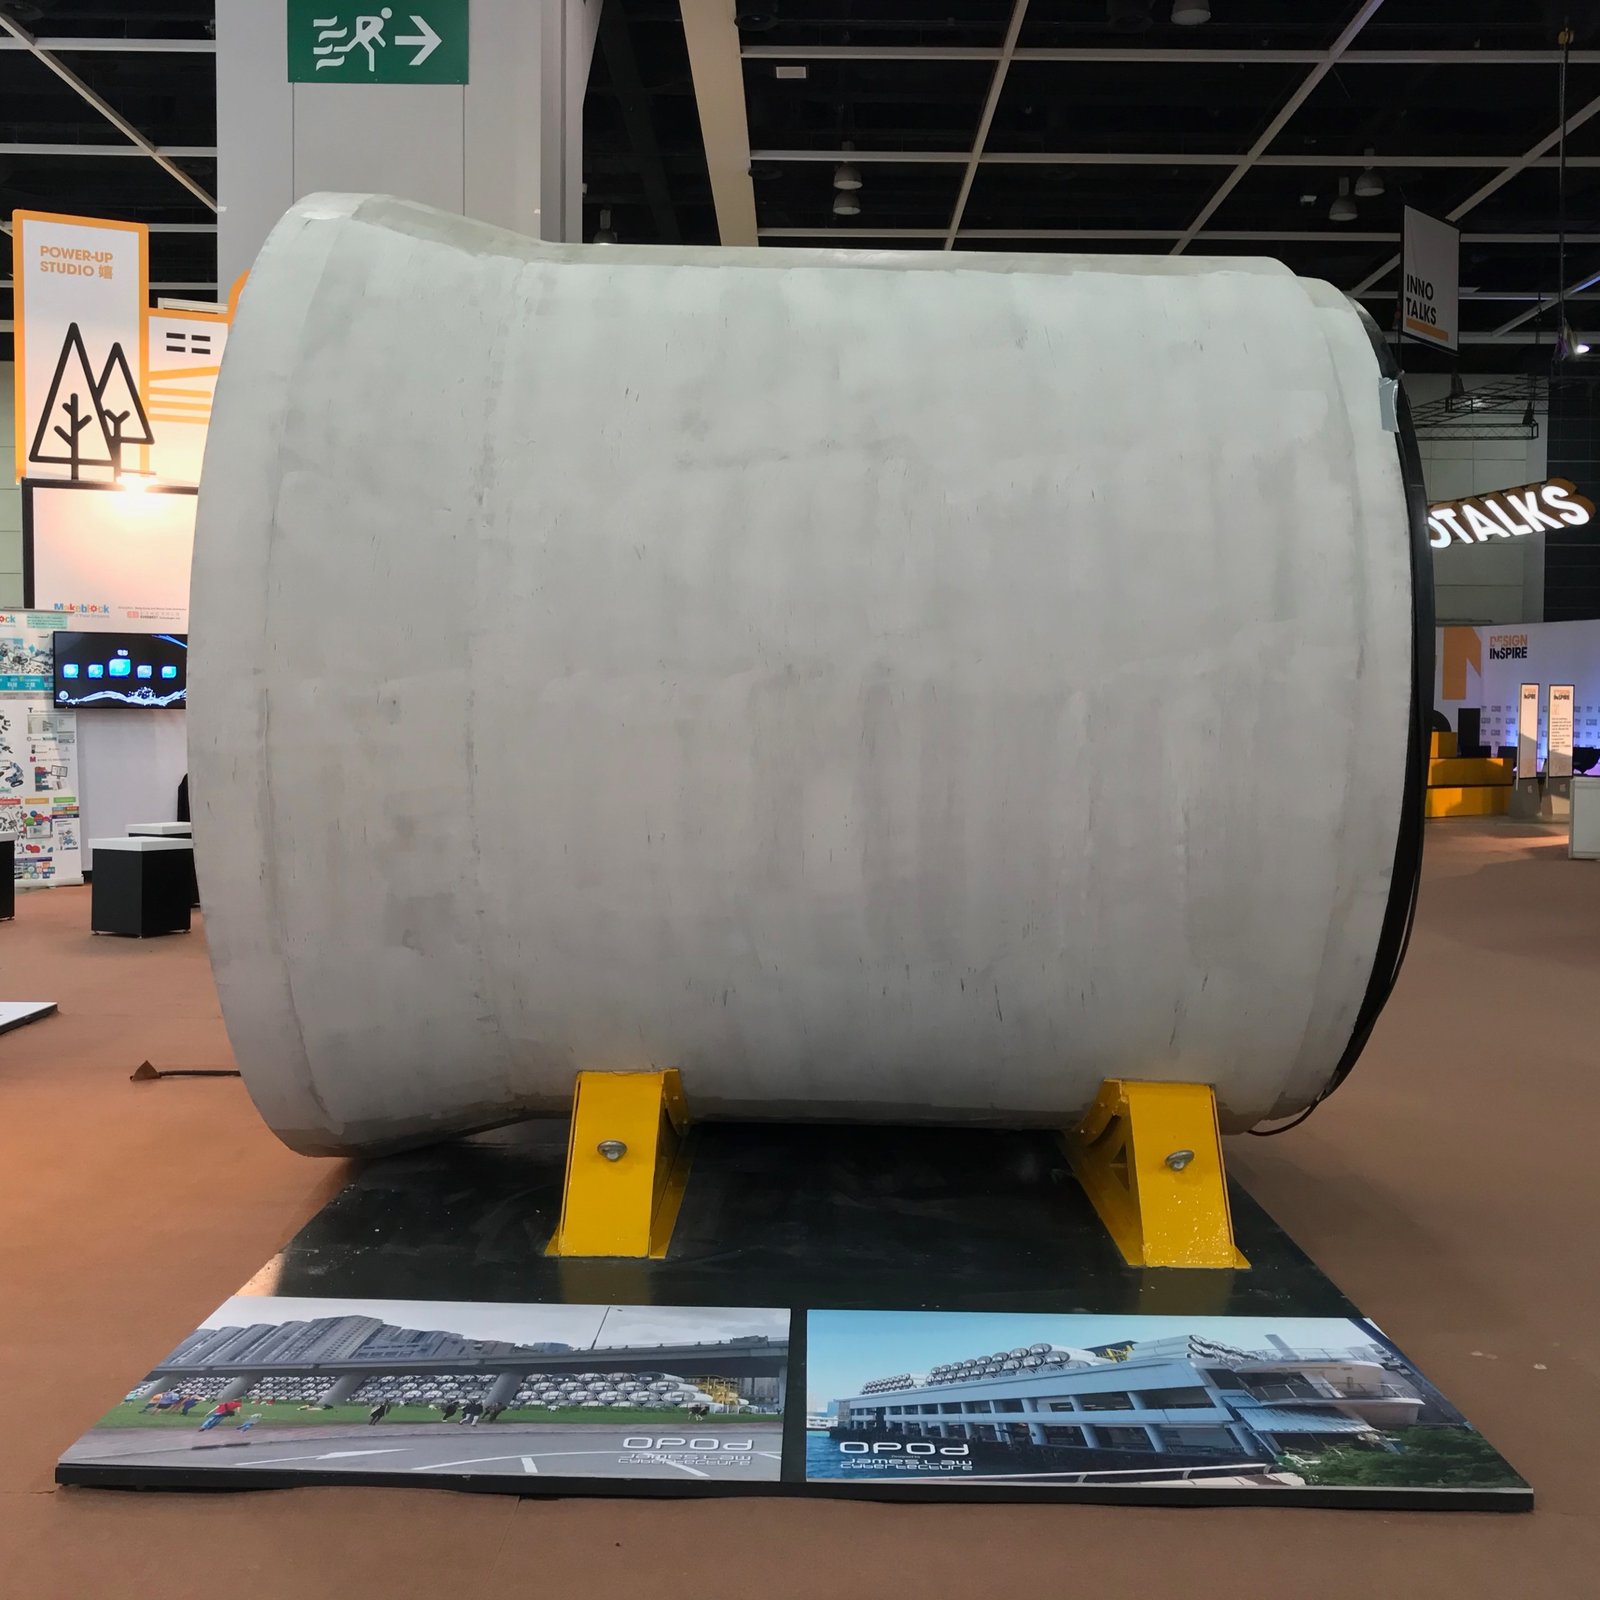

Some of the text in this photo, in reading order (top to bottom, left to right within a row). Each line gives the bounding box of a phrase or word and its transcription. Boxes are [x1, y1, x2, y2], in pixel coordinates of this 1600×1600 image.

[40, 245, 113, 263] POWER-UP
[40, 260, 94, 277] STUDIO
[1406, 274, 1434, 300] INNO
[1406, 298, 1437, 326] TALKS
[54, 603, 110, 614] Makeblock
[1489, 634, 1528, 647] DESIGN
